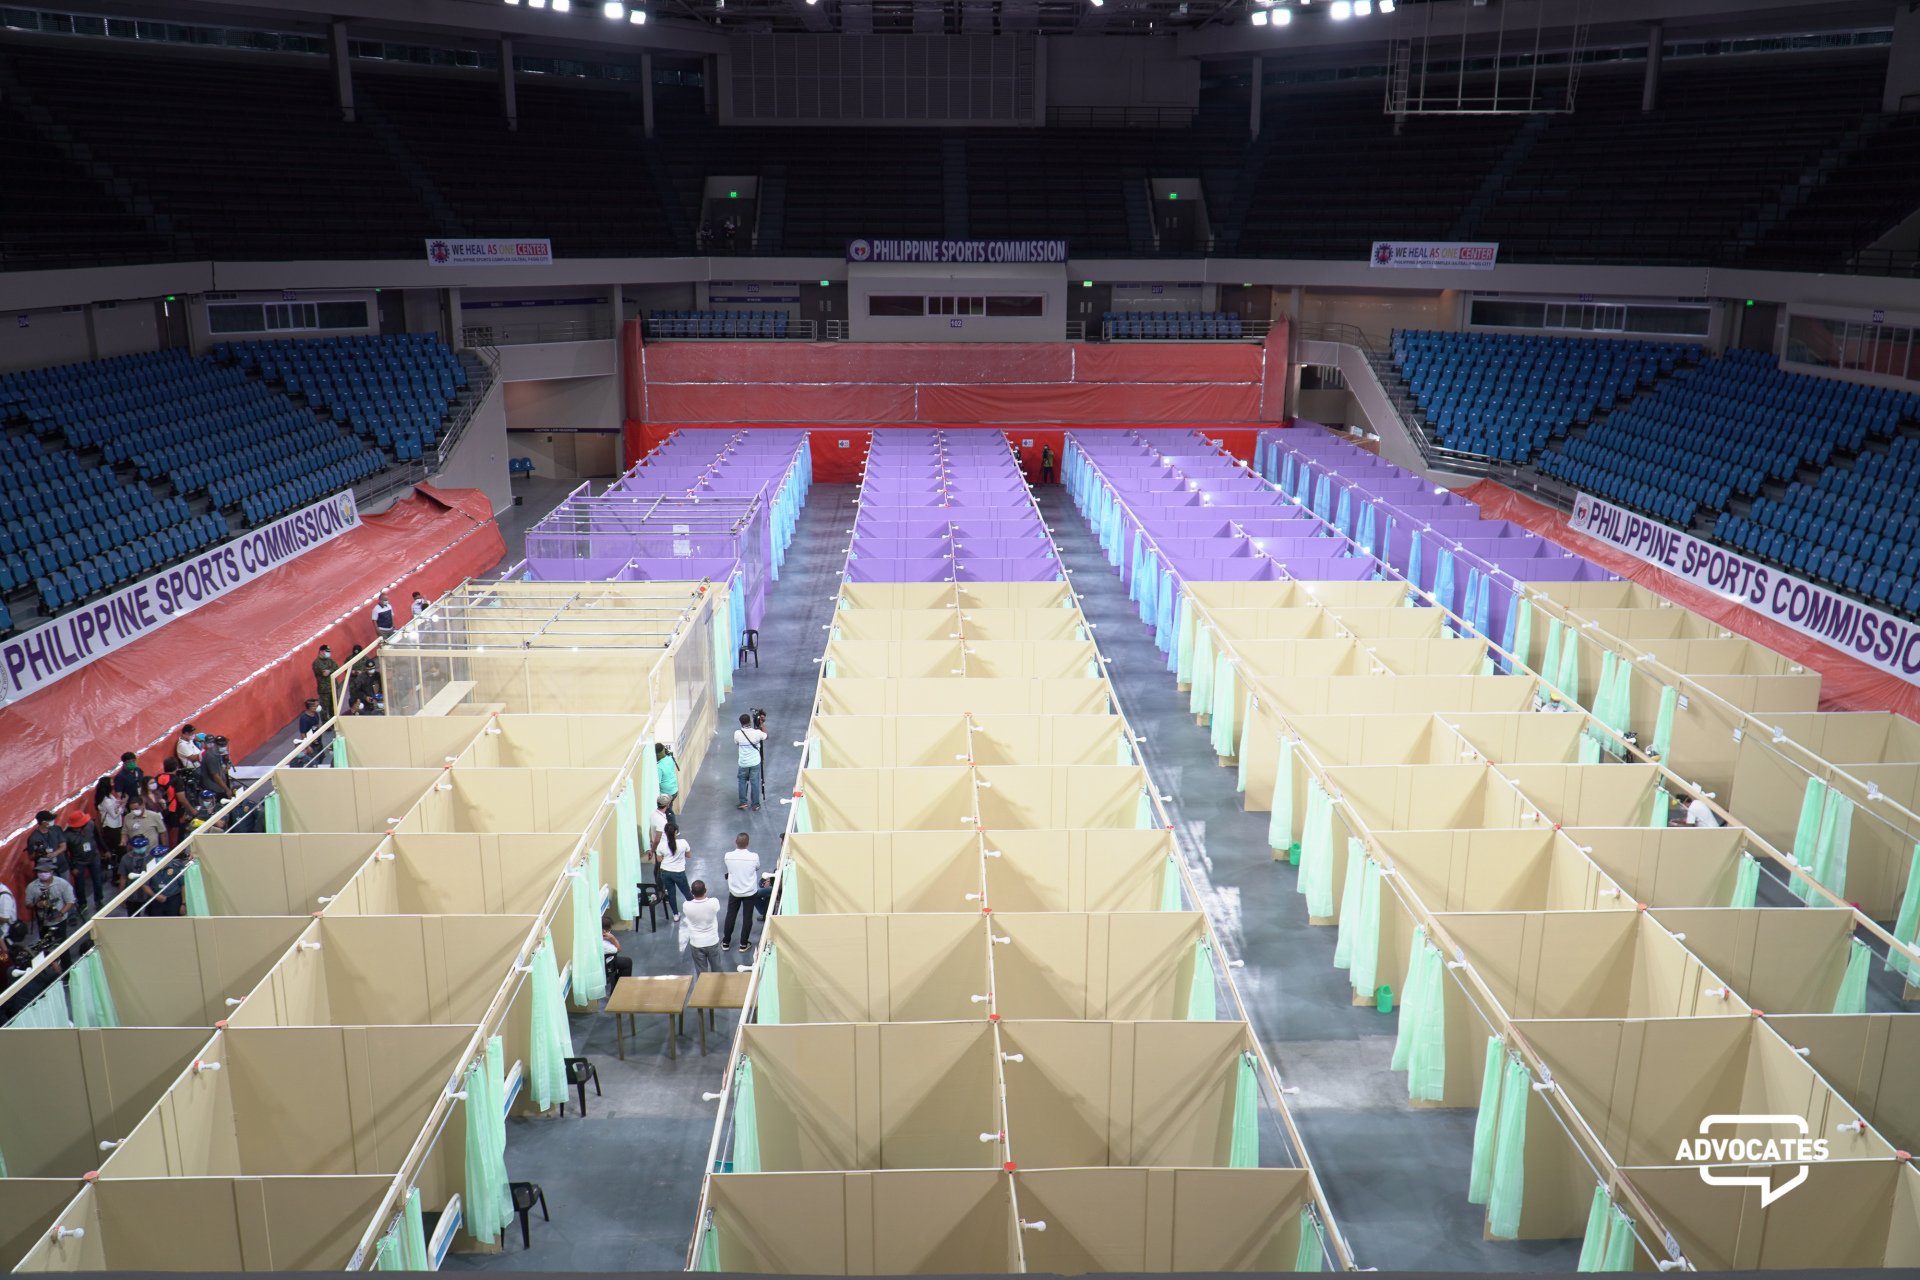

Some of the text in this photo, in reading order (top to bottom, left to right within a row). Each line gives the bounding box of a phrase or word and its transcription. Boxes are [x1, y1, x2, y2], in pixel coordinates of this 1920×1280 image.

[451, 244, 548, 255] WE HEAL AS ONE CENTER
[873, 240, 1066, 262] PHILIPPINE SPORTS COMMISSION
[1395, 247, 1493, 259] WE HEAL AS ONE CENTER
[4, 586, 158, 692] PHILIPPINE
[154, 551, 241, 616] SPORTS
[240, 500, 344, 574] COMMISSION
[1586, 501, 1920, 675] PHILIPPINE SPORTS COMMISSIO
